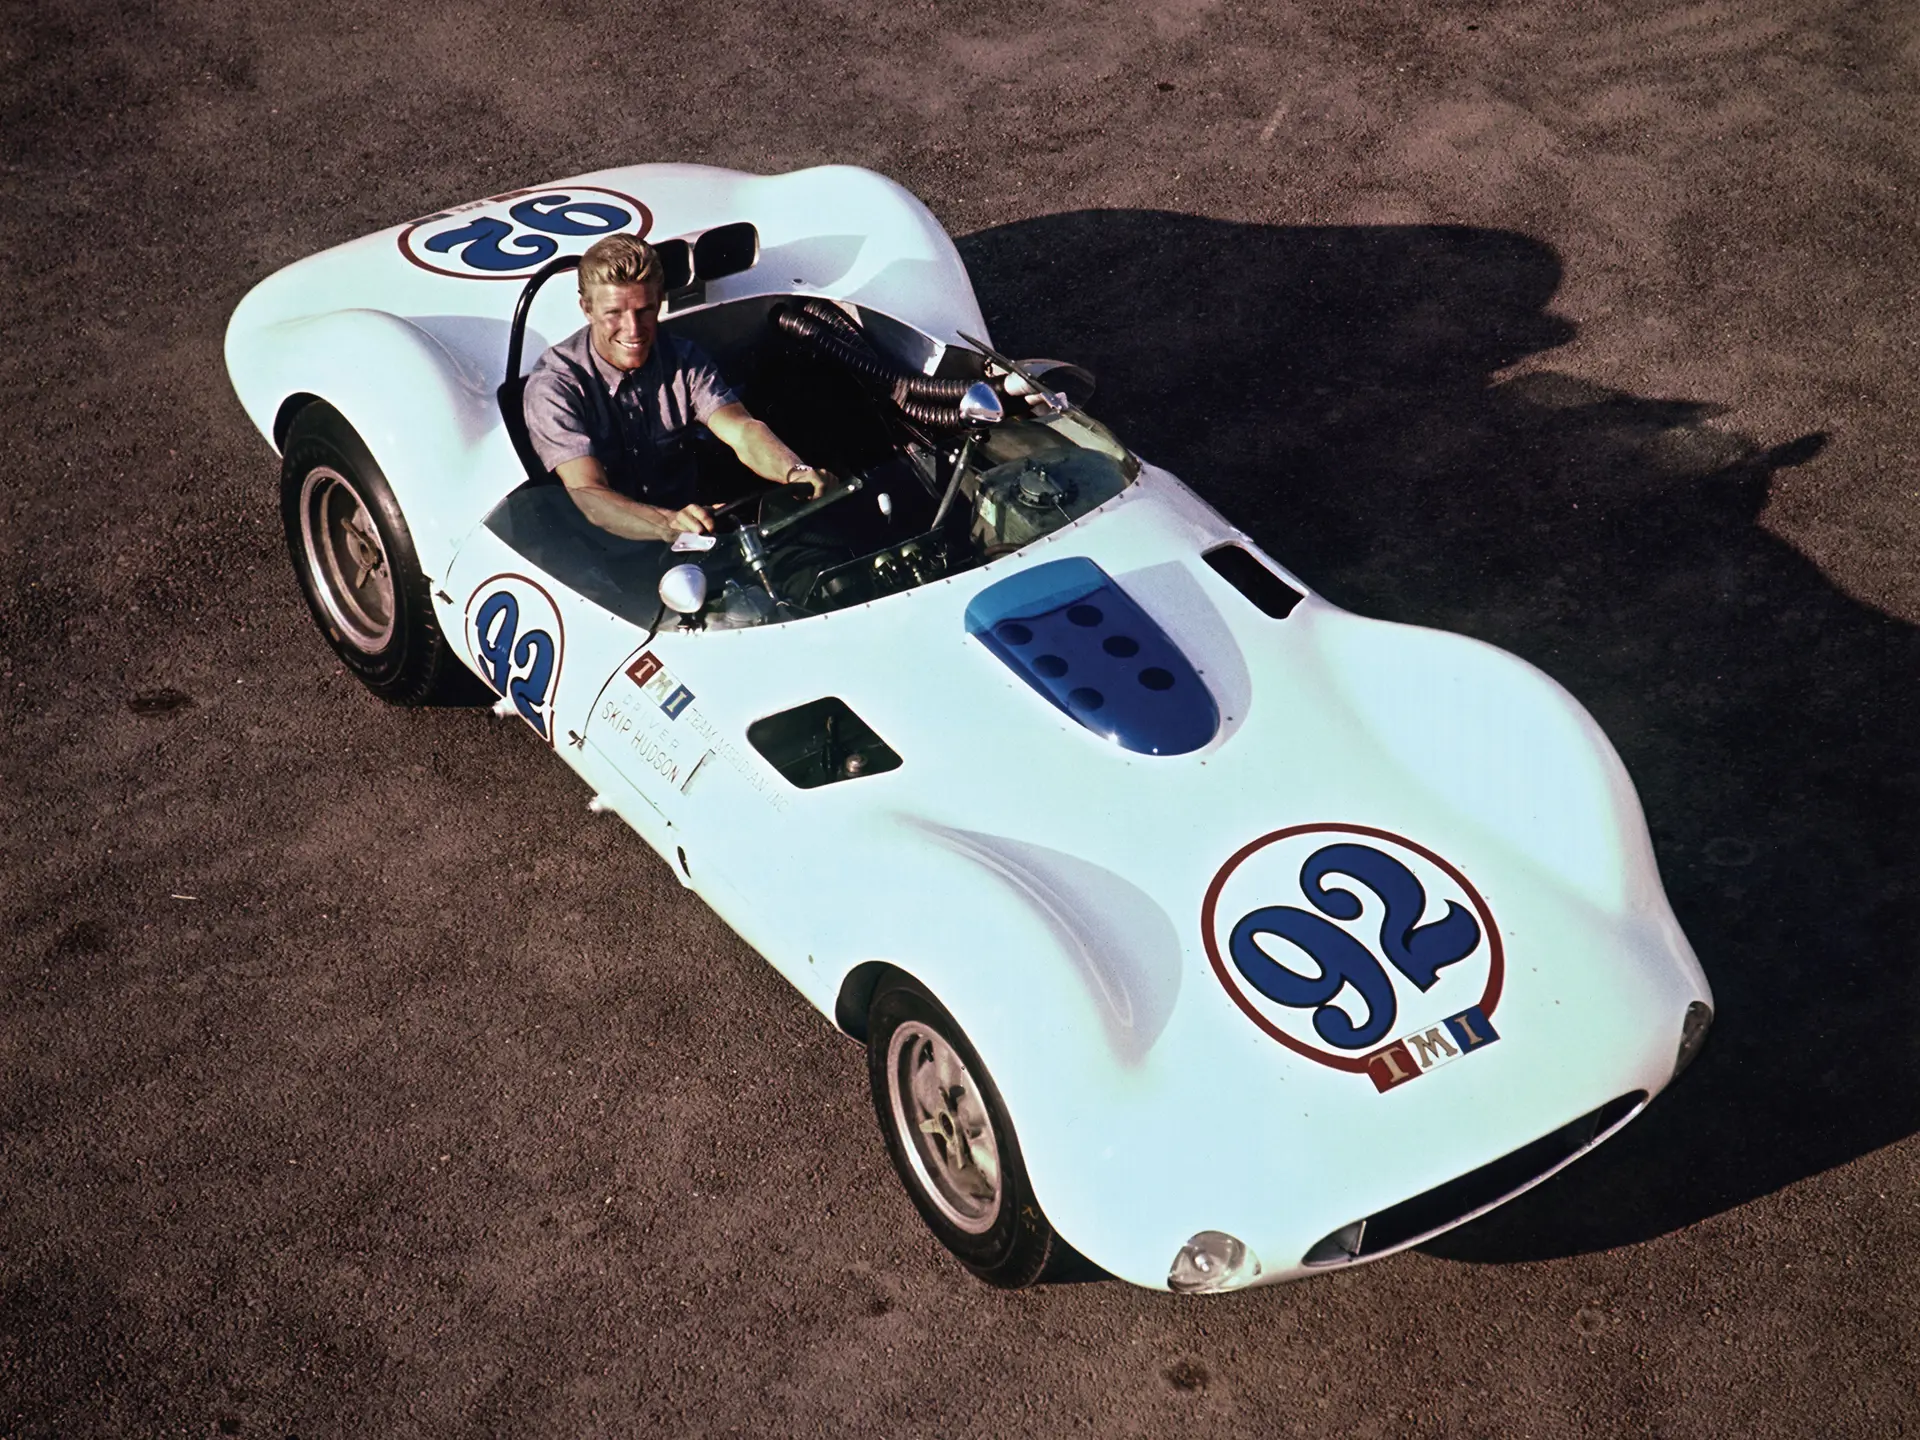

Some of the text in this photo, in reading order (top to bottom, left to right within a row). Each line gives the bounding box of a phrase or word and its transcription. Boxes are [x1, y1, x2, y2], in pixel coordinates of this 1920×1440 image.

[424, 194, 632, 271] 92
[475, 590, 555, 738] 92
[633, 657, 688, 714] TMI
[601, 700, 681, 784] SKIP HUDSON
[621, 693, 680, 749] DRIVER
[685, 707, 718, 742] TEAM
[1229, 843, 1481, 1050] 92
[1367, 1014, 1484, 1084] TMI
